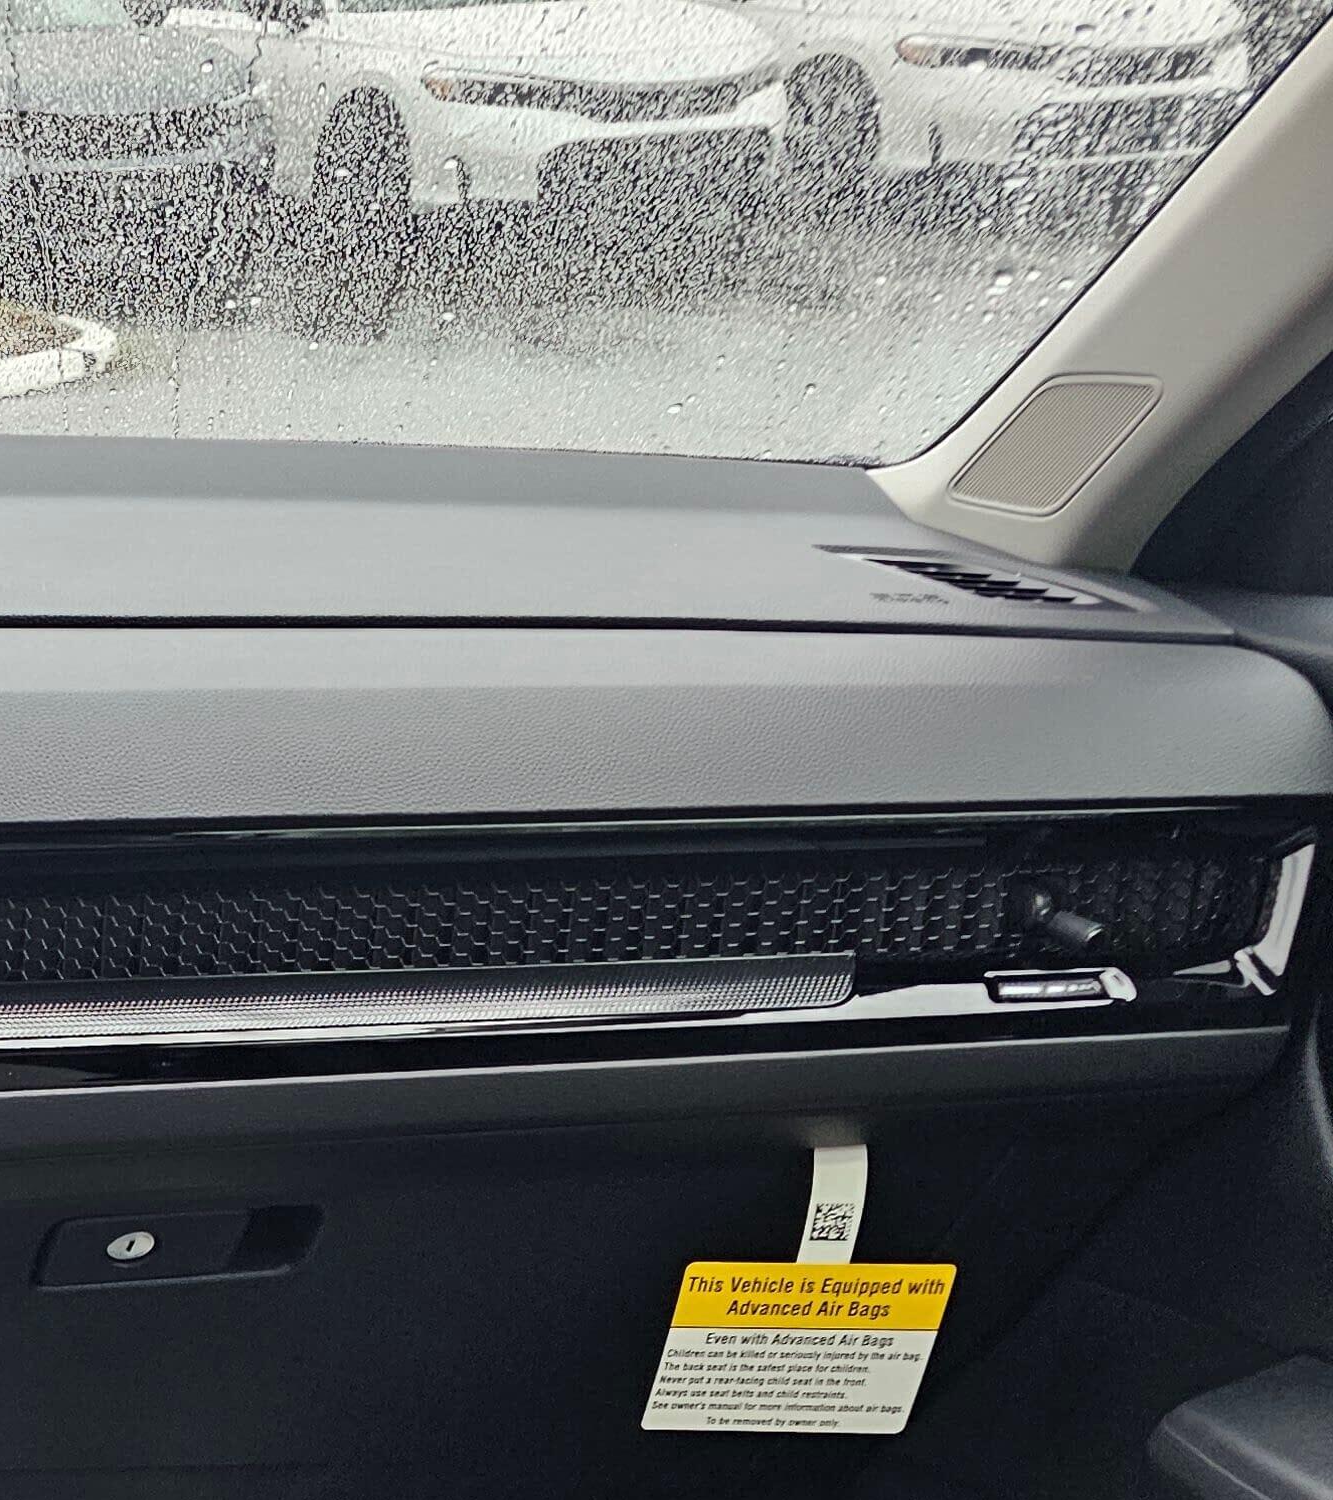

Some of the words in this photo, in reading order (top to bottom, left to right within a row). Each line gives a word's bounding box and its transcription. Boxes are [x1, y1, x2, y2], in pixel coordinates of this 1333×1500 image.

[689, 1276, 724, 1293] This
[731, 1277, 795, 1294] Vehicle
[800, 1278, 816, 1294] is
[821, 1278, 904, 1298] Equipped
[907, 1279, 946, 1295] with
[726, 1300, 813, 1316] Advanced
[816, 1300, 845, 1317] Air
[848, 1301, 891, 1320] Bags
[705, 1332, 737, 1345] Even
[740, 1333, 769, 1345] with
[771, 1333, 836, 1346] Advanced
[838, 1334, 860, 1346] Air
[861, 1335, 895, 1349] Bags
[667, 1348, 706, 1359] Children
[707, 1350, 725, 1358] can
[726, 1349, 739, 1359] be
[740, 1350, 767, 1359] killed
[767, 1351, 779, 1360] or
[779, 1351, 821, 1361] seriously
[822, 1351, 856, 1361] injured
[857, 1351, 870, 1362] by
[870, 1352, 886, 1360] the
[887, 1352, 902, 1361] air
[664, 1361, 680, 1371] The
[682, 1362, 705, 1371] back
[706, 1363, 728, 1372] seat
[728, 1363, 738, 1372] is
[739, 1363, 755, 1372] the
[756, 1363, 786, 1373] safest
[786, 1364, 813, 1374] place
[814, 1364, 829, 1373] for
[658, 1375, 687, 1385] Never
[687, 1377, 705, 1386] put
[713, 1376, 765, 1387] rear-facing
[766, 1377, 791, 1386] child
[792, 1378, 813, 1387] seat
[814, 1377, 824, 1387] in
[825, 1378, 841, 1386] the
[654, 1387, 688, 1398] Always
[689, 1390, 707, 1398] use
[709, 1389, 731, 1397] seat
[731, 1389, 755, 1399] belts
[756, 1389, 775, 1399] and
[776, 1390, 800, 1399] child
[652, 1401, 670, 1410] See
[671, 1401, 707, 1411] owner's
[707, 1402, 743, 1411] manual
[743, 1402, 758, 1411] for
[758, 1404, 782, 1412] more
[783, 1403, 836, 1413] information
[836, 1404, 865, 1413] about
[865, 1405, 880, 1413] air
[706, 1416, 717, 1426] To
[718, 1417, 731, 1426] be
[731, 1417, 773, 1427] removed
[773, 1418, 787, 1428] by
[787, 1419, 819, 1428] owner
